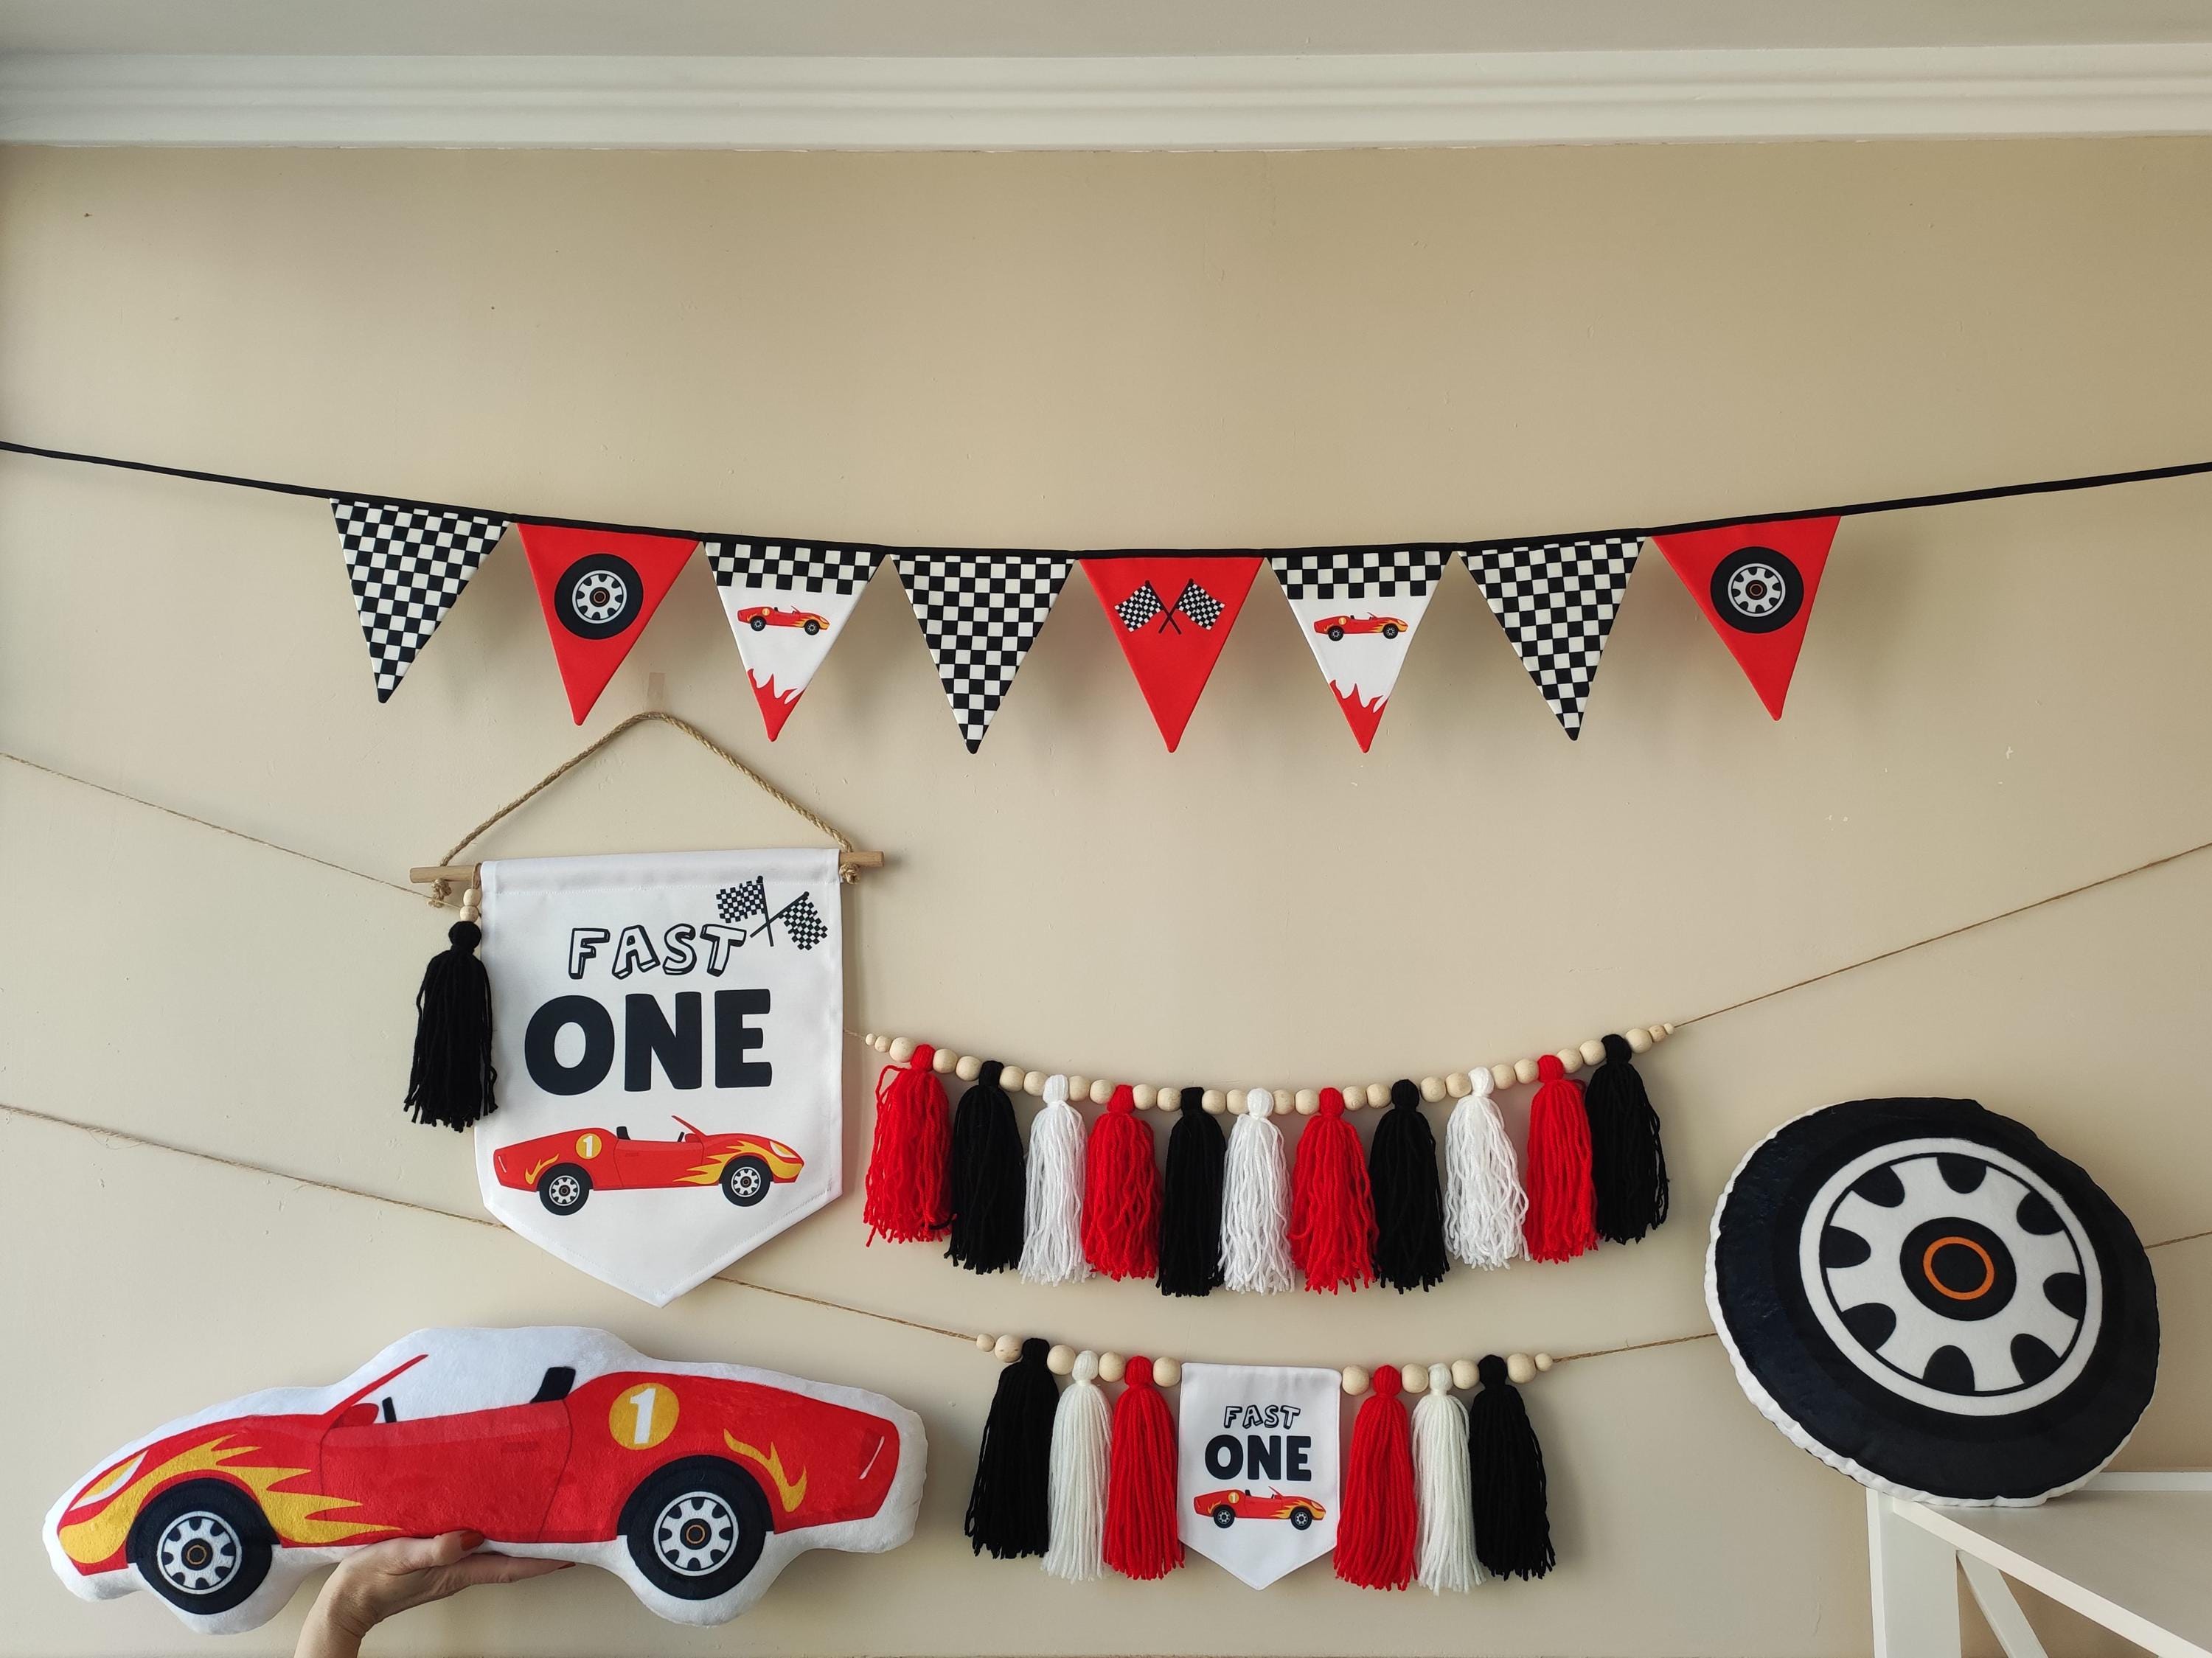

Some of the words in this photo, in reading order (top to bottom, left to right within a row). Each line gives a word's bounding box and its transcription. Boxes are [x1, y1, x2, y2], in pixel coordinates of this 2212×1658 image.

[568, 923, 747, 980] FAST
[524, 989, 773, 1096] ONE
[582, 1135, 593, 1157] 1
[630, 1387, 656, 1444] 1
[1223, 1404, 1301, 1429] FAST
[1205, 1434, 1312, 1481] ONE
